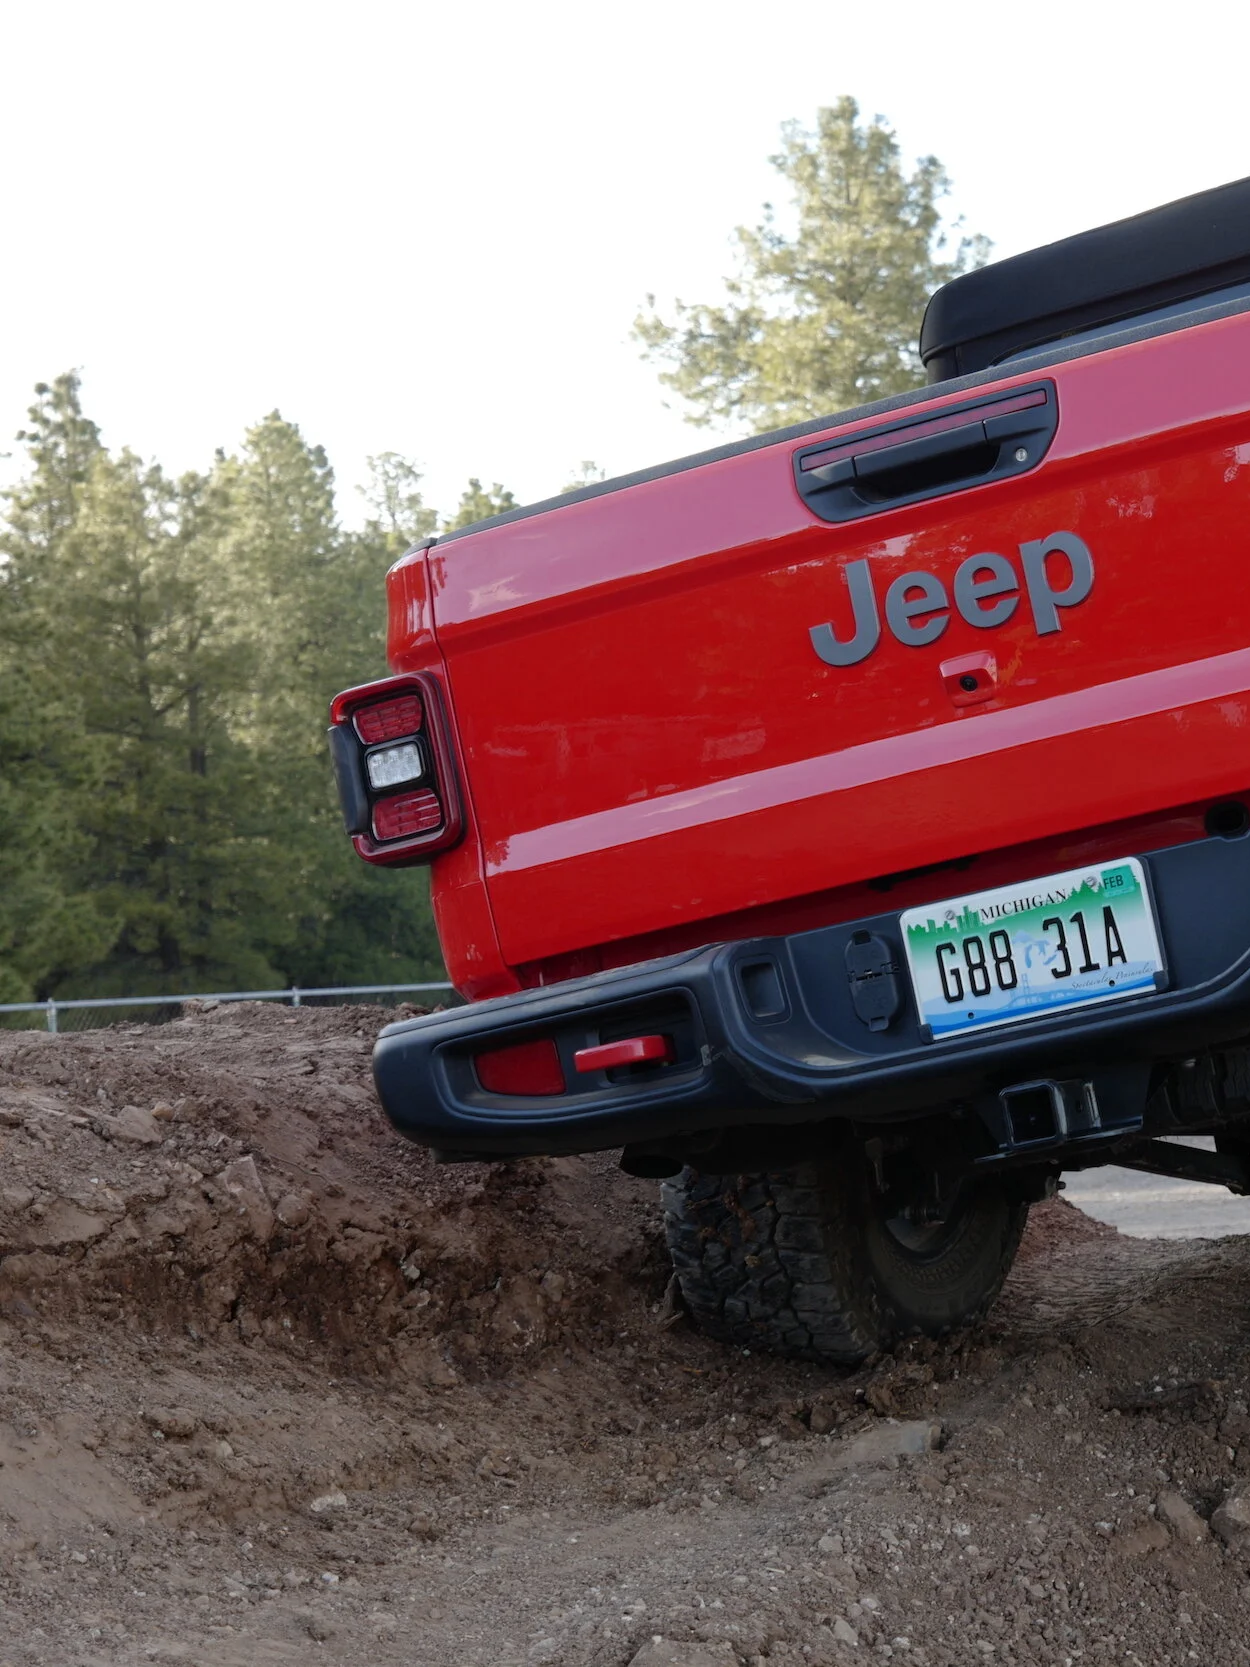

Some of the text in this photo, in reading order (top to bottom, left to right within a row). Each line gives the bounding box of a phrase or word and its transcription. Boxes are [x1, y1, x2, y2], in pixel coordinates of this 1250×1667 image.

[808, 530, 1095, 667] Jeep
[980, 889, 1067, 920] MICHIGAN
[1103, 875, 1124, 890] FEB
[936, 905, 1127, 1004] G88 31A
